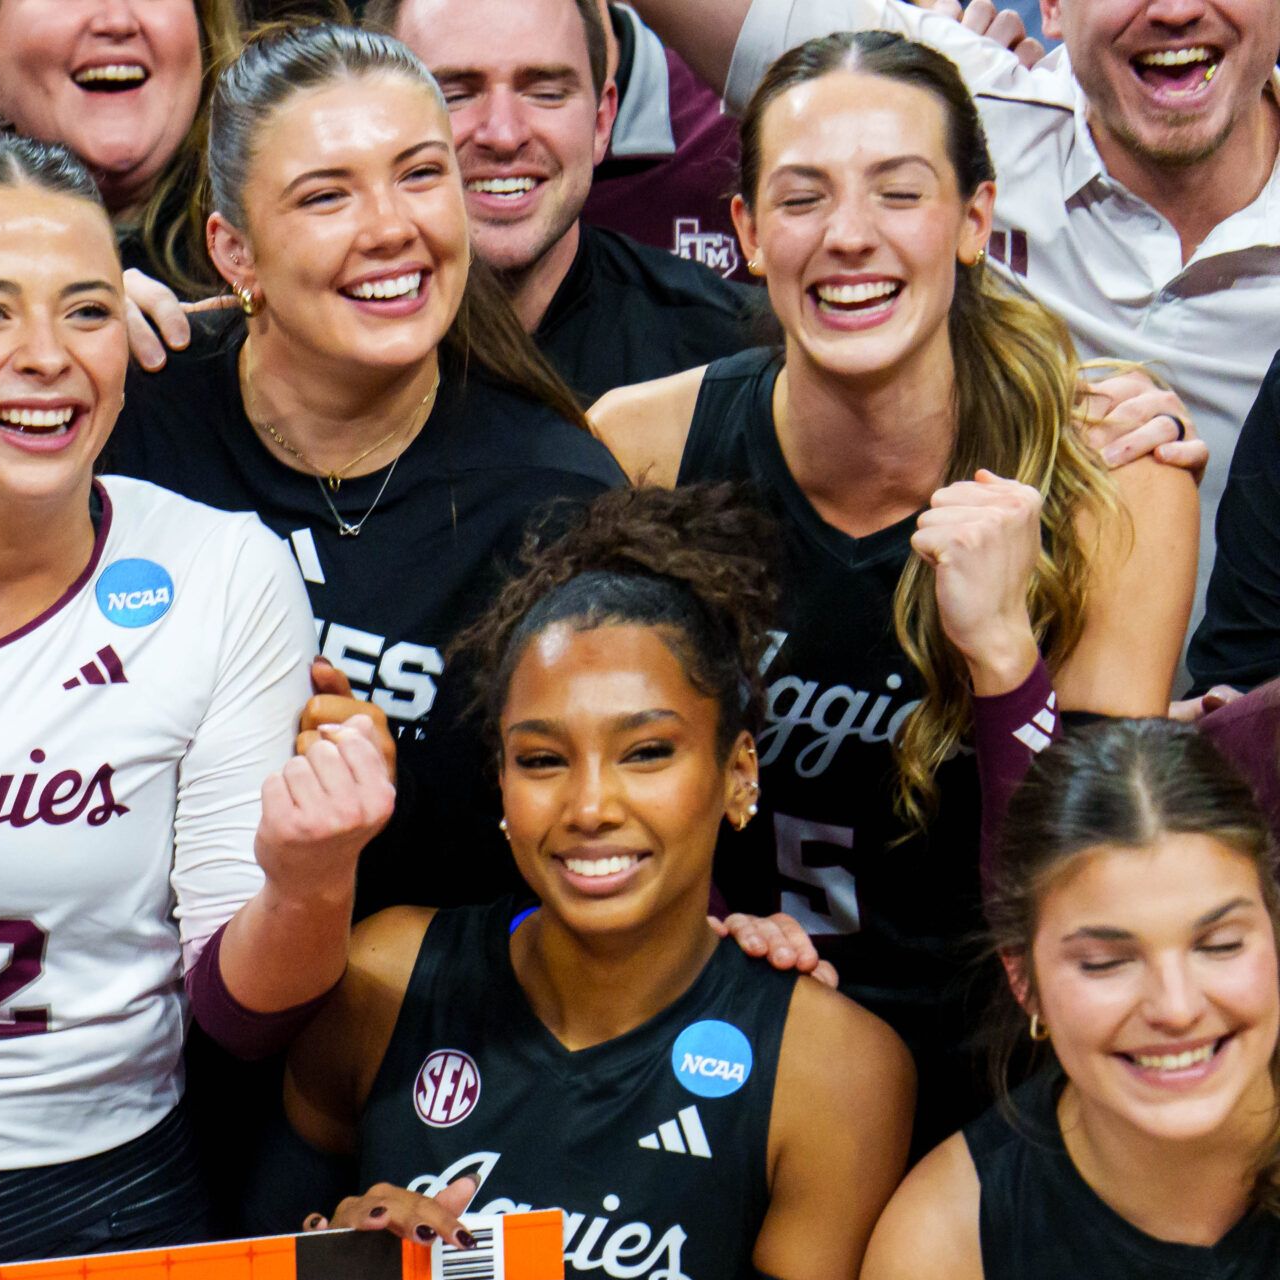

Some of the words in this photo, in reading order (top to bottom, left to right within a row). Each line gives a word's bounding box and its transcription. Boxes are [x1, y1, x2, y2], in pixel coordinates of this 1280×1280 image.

[107, 587, 170, 611] NCAA
[679, 1052, 746, 1083] NCAA
[417, 1054, 476, 1124] SEC
